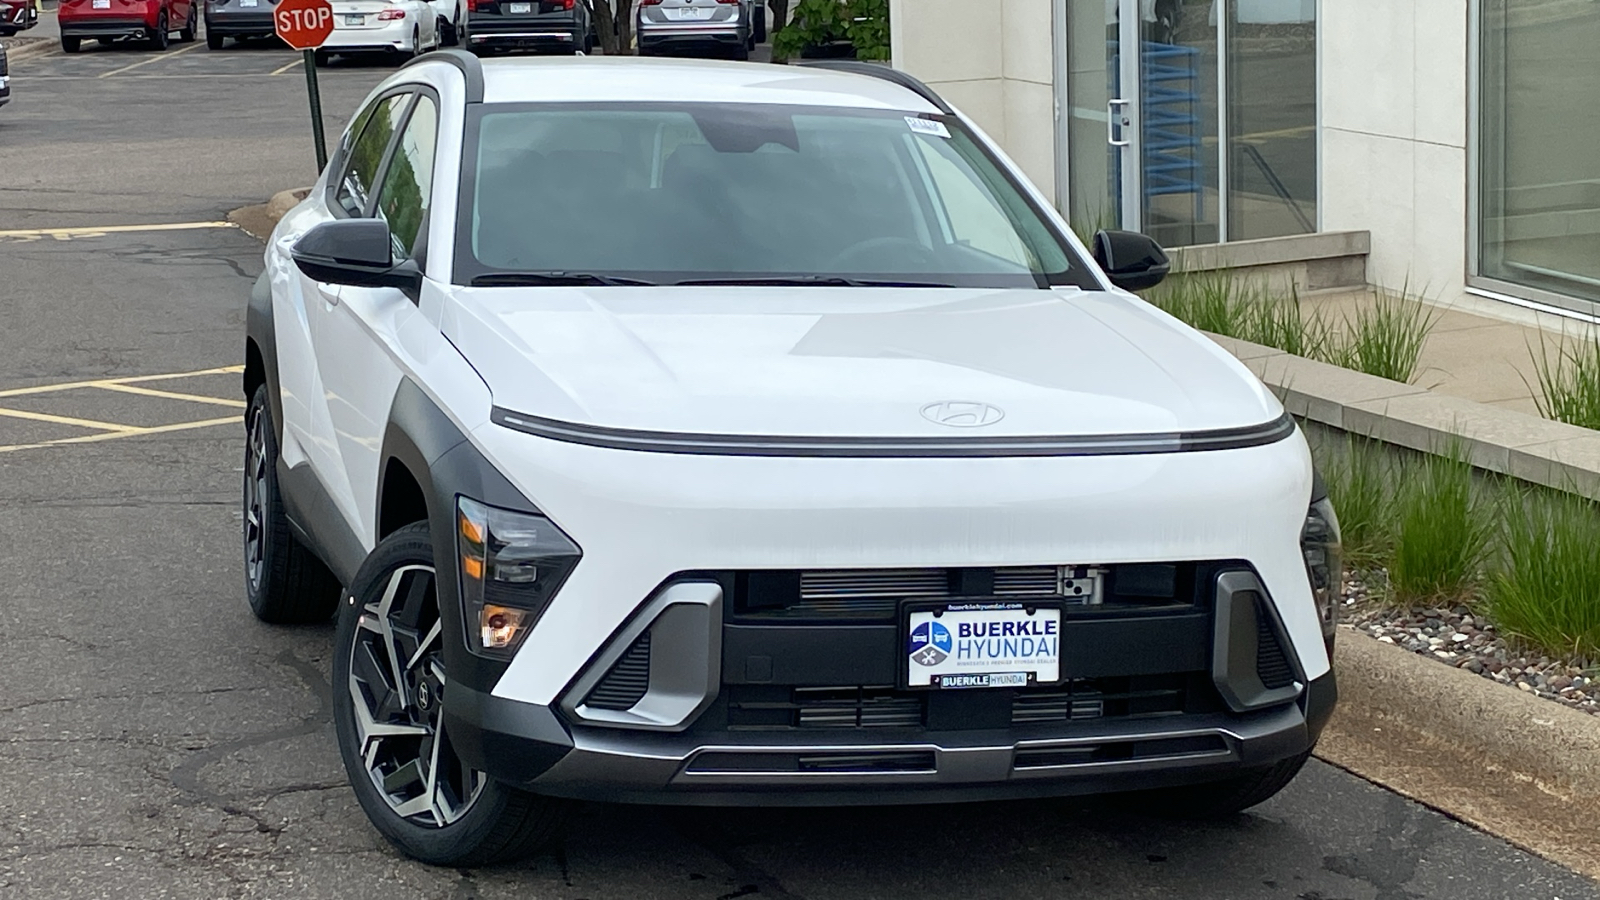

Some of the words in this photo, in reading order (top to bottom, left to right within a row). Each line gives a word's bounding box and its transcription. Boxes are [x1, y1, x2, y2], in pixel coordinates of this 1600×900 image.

[279, 7, 330, 32] STOP
[958, 620, 1057, 638] BUERKLE
[957, 638, 1057, 660] HYUNDAI
[942, 675, 989, 687] BUERKLE
[990, 674, 1025, 685] HYUNDAI
